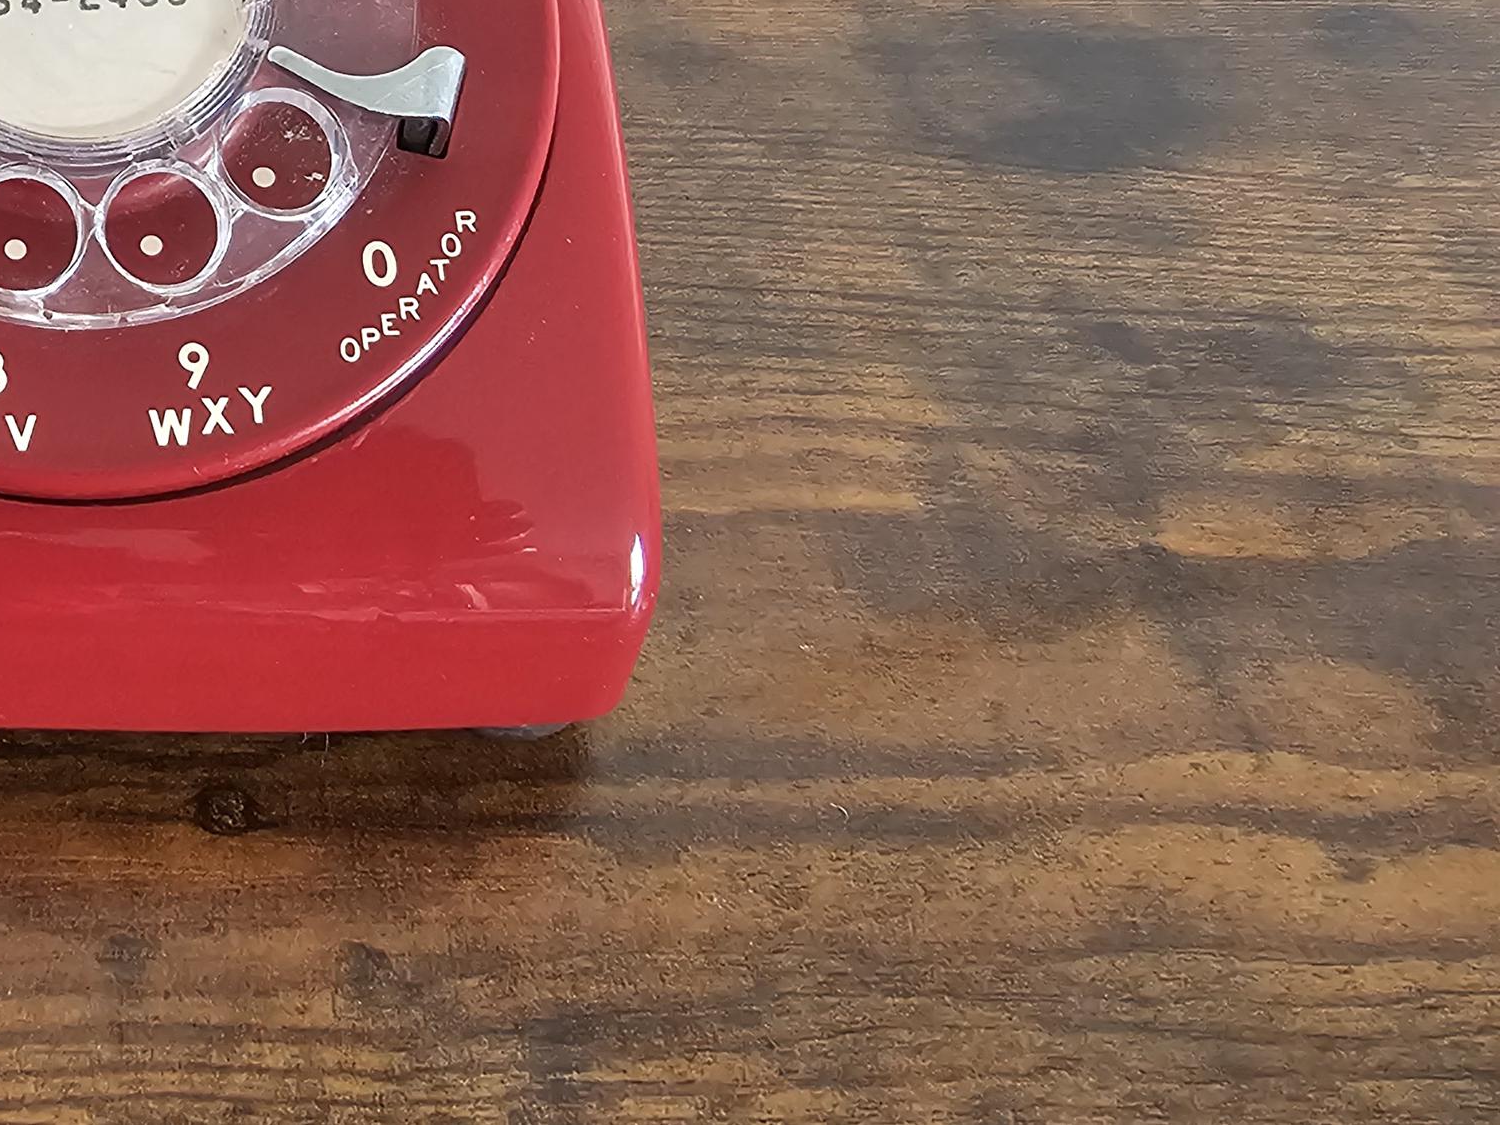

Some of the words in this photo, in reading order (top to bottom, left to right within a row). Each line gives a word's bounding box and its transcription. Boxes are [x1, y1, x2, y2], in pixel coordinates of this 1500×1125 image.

[339, 210, 477, 363] OPERATOR
[362, 240, 398, 288] 0
[178, 342, 210, 390] 9
[148, 386, 273, 447] WXY
